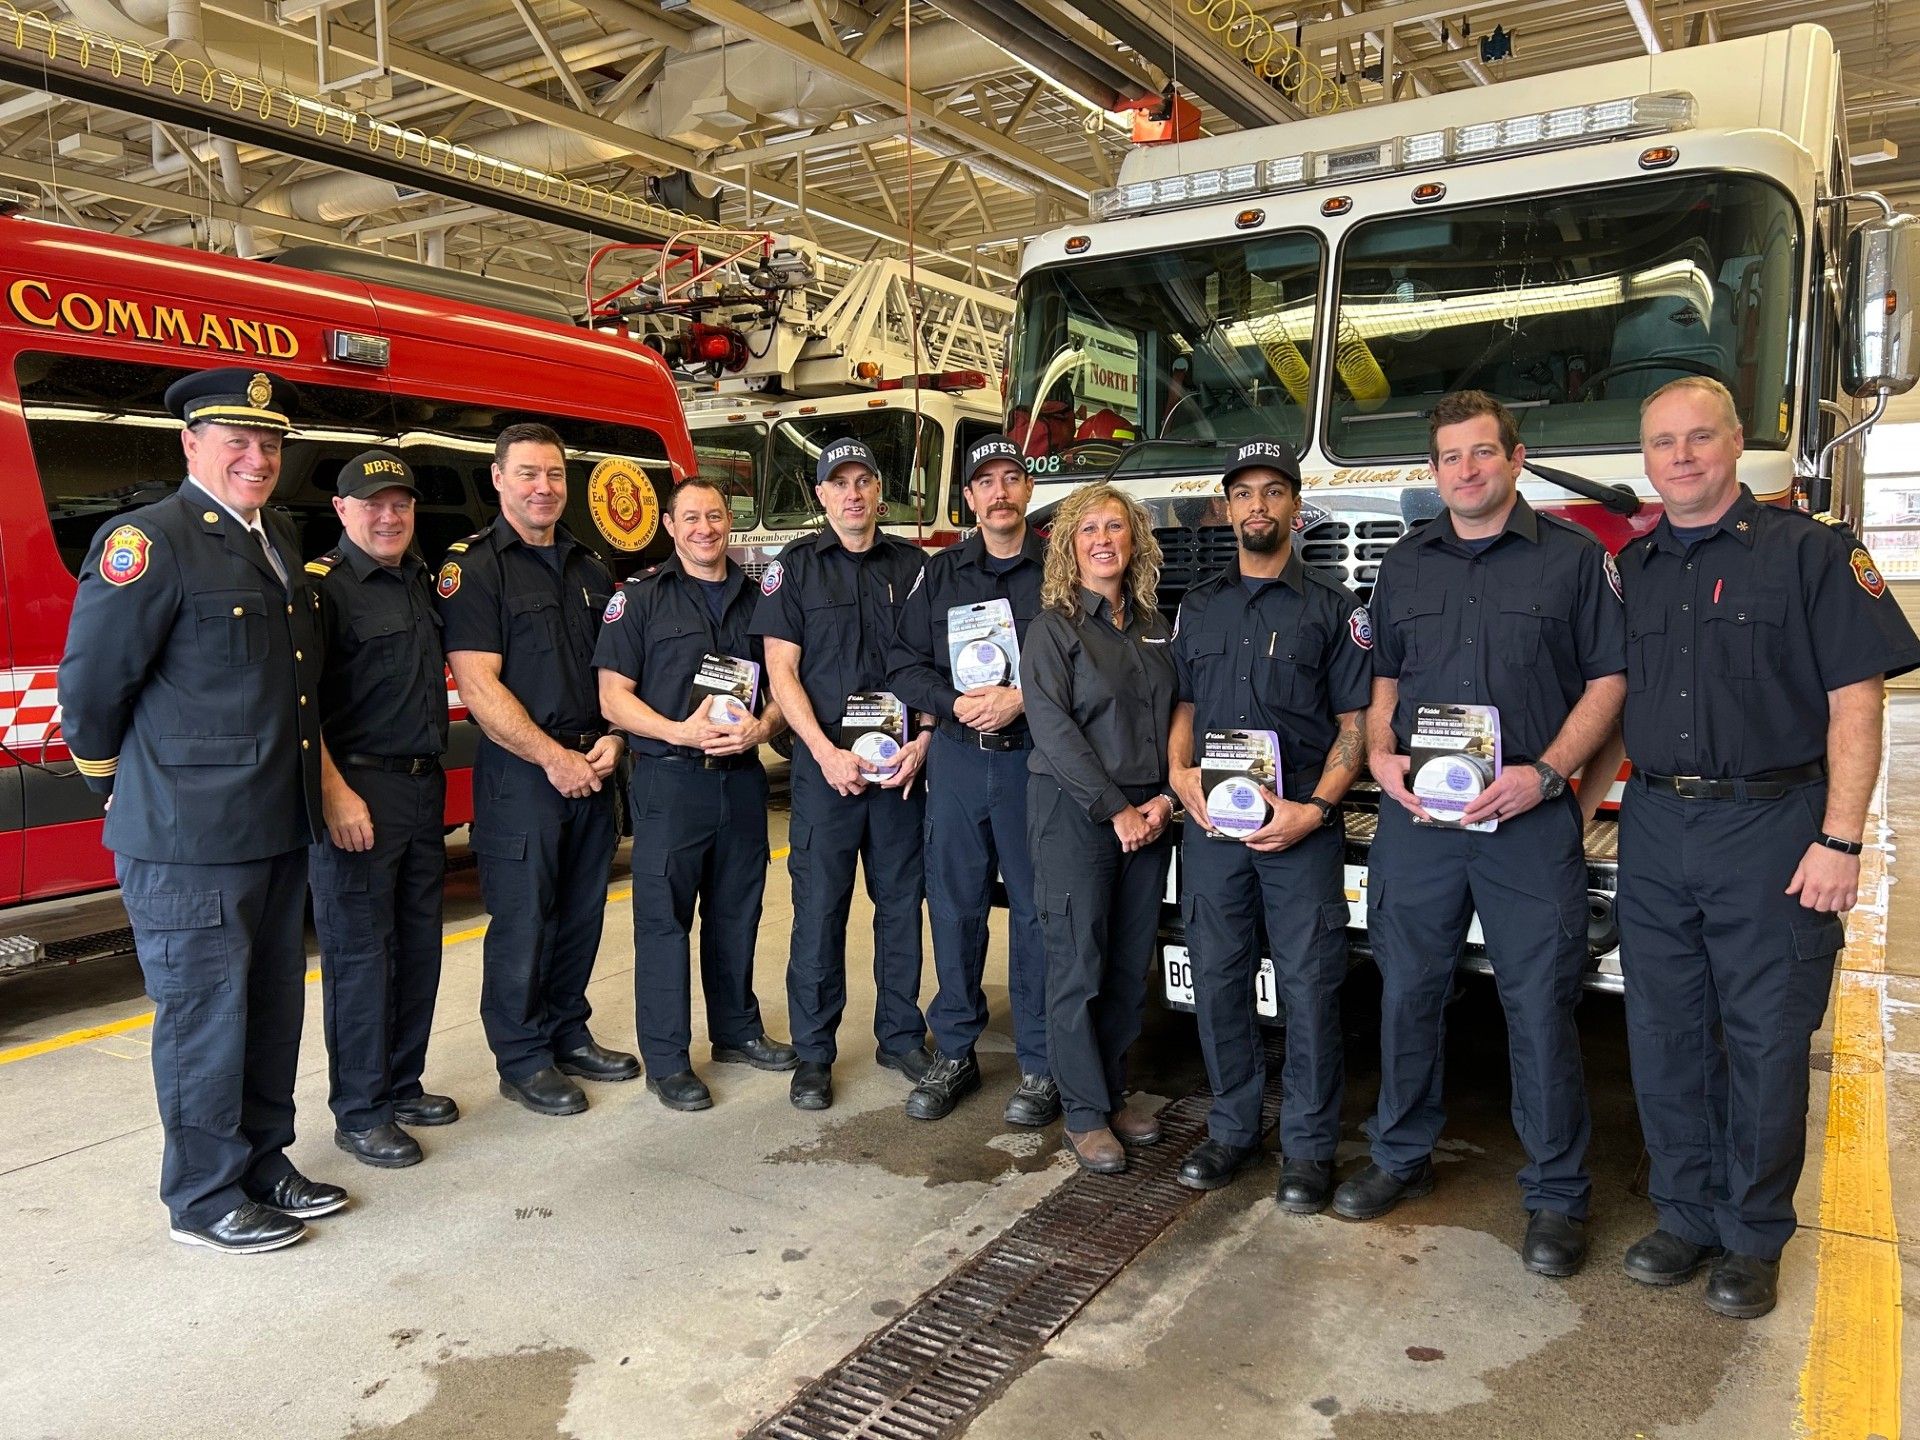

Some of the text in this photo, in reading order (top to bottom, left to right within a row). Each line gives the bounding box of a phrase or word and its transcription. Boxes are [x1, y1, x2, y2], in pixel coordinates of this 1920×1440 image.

[8, 279, 299, 359] COMMAND
[1090, 362, 1128, 393] NORTH
[827, 444, 867, 463] NBFES
[971, 442, 1017, 463] NBFES
[1237, 442, 1281, 461] NBFES
[363, 459, 405, 476] NBFES
[1025, 455, 1060, 473] 908
[591, 460, 616, 489] COMMUNITY
[1328, 468, 1402, 486] Elliott
